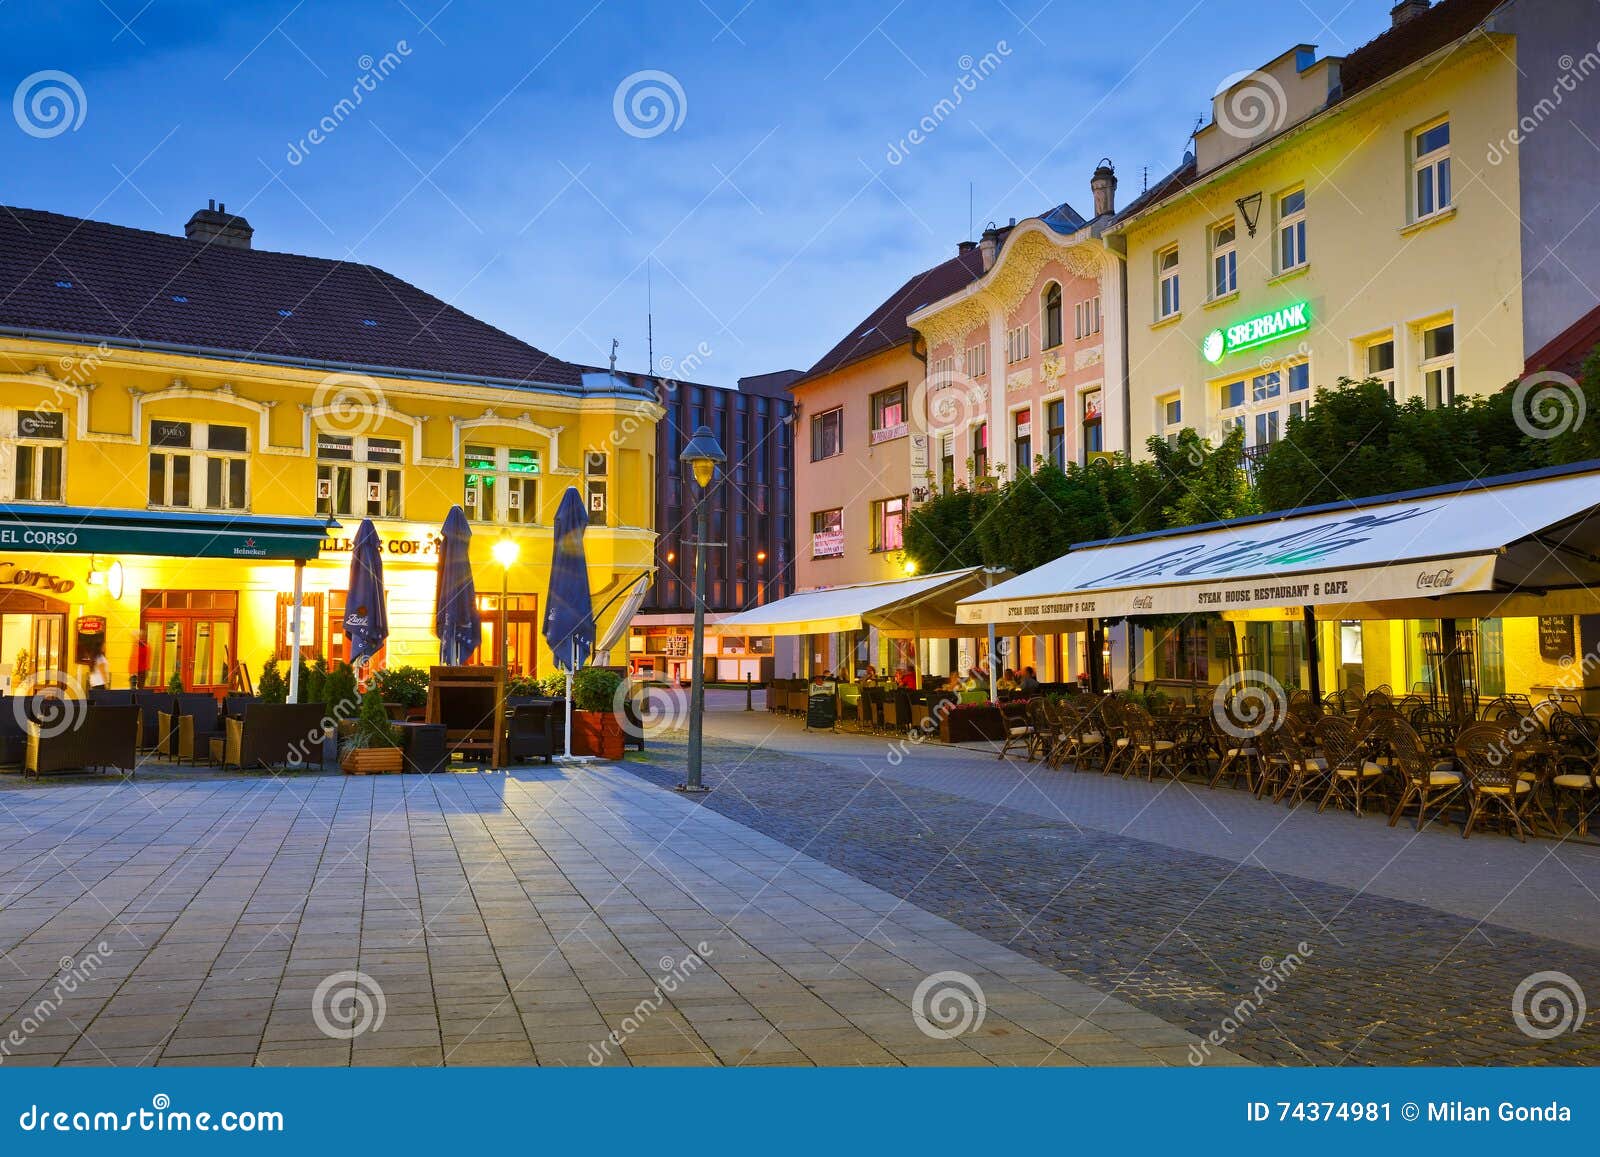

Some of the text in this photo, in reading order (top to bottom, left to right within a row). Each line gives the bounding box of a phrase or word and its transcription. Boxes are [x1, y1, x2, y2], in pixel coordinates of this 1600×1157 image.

[1227, 303, 1307, 347] SBERBANK
[1, 530, 78, 545] EL CORSO
[233, 547, 267, 556] Heineken
[1198, 581, 1348, 604] STEAK HOUSE RESTAURANT & CAFE
[1008, 607, 1022, 617] STEAK
[1024, 605, 1039, 615] HOUSE
[1041, 603, 1073, 614] RESTAURANT
[1081, 601, 1096, 612] CAFE
